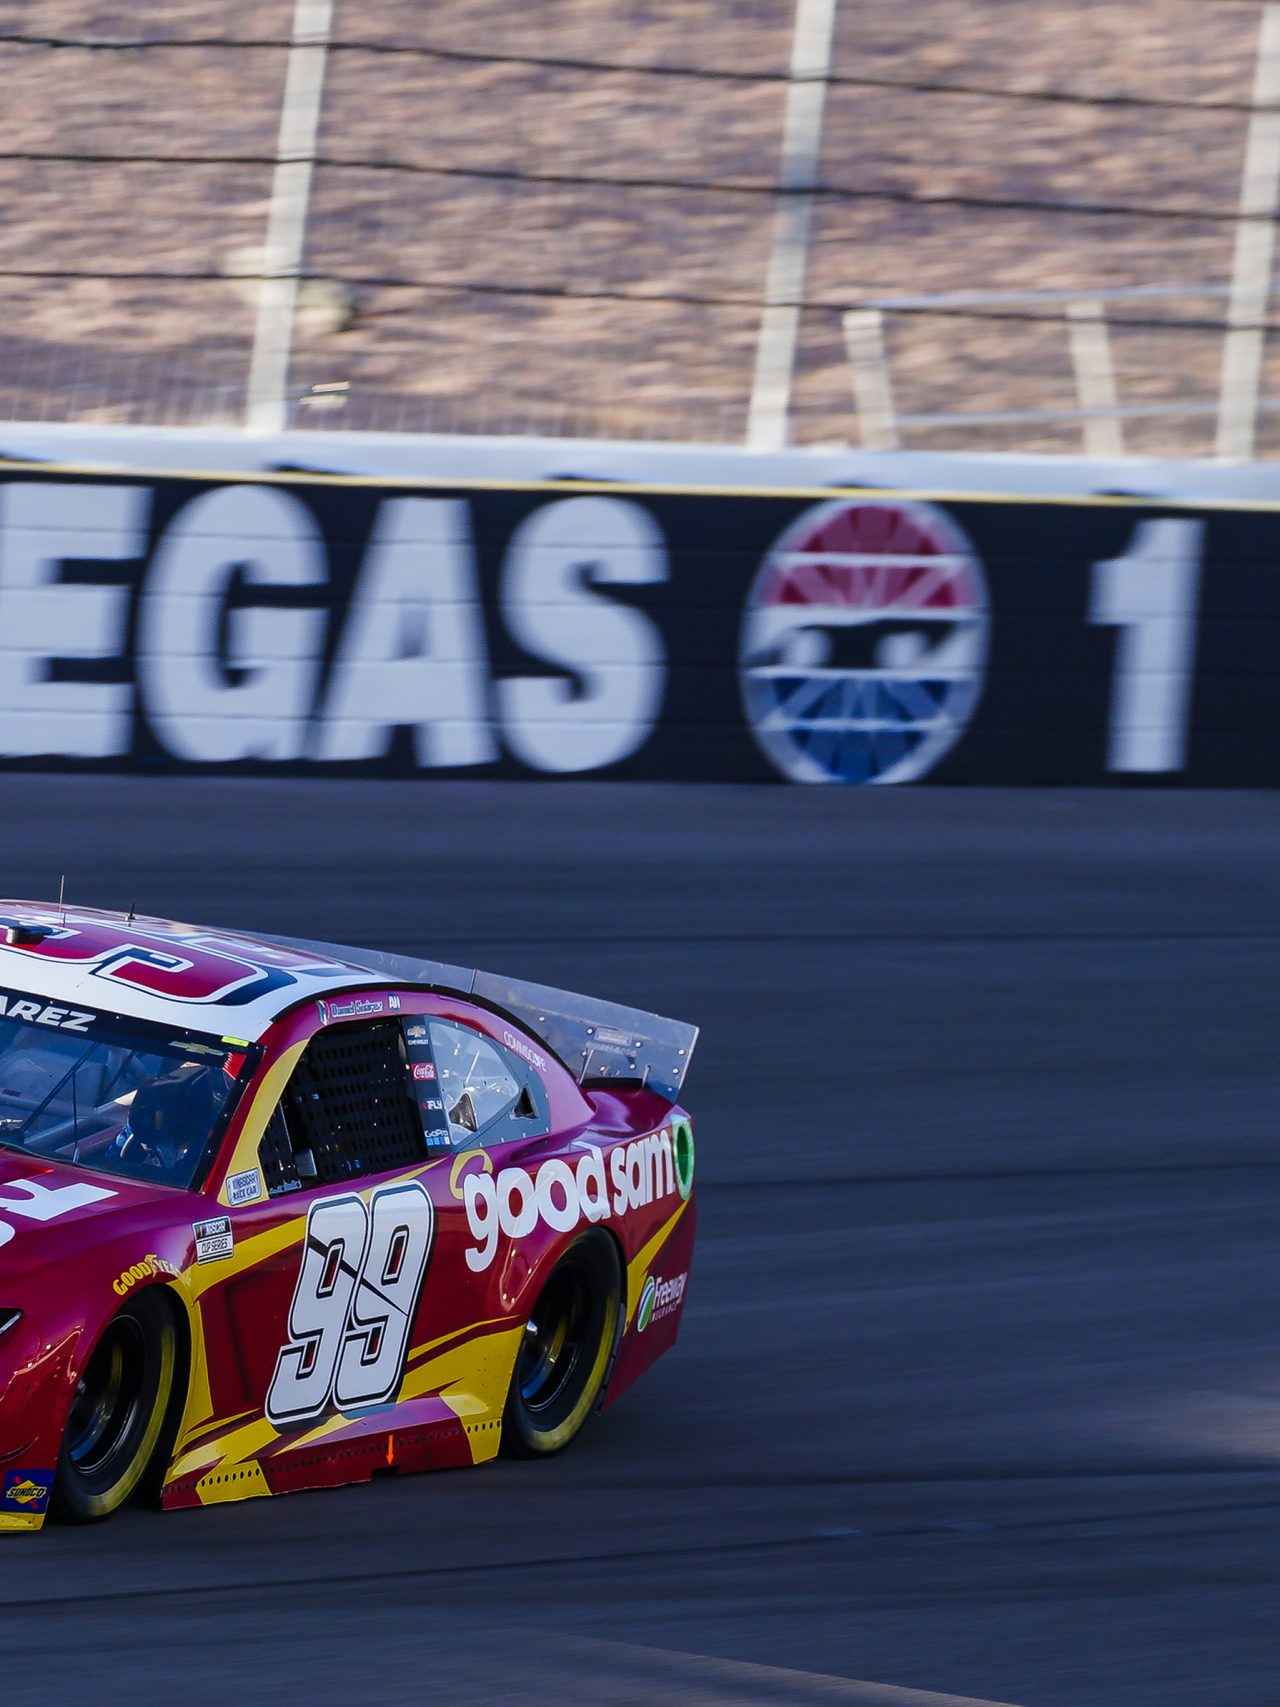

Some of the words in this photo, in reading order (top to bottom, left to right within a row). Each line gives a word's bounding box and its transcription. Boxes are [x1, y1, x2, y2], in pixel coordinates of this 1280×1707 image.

[1088, 519, 1205, 773] 1
[424, 1129, 450, 1138] GoPro
[463, 1140, 613, 1273] good
[610, 1130, 676, 1217] sam
[264, 1179, 435, 1427] 99
[6, 1486, 48, 1500] SUNOCO
